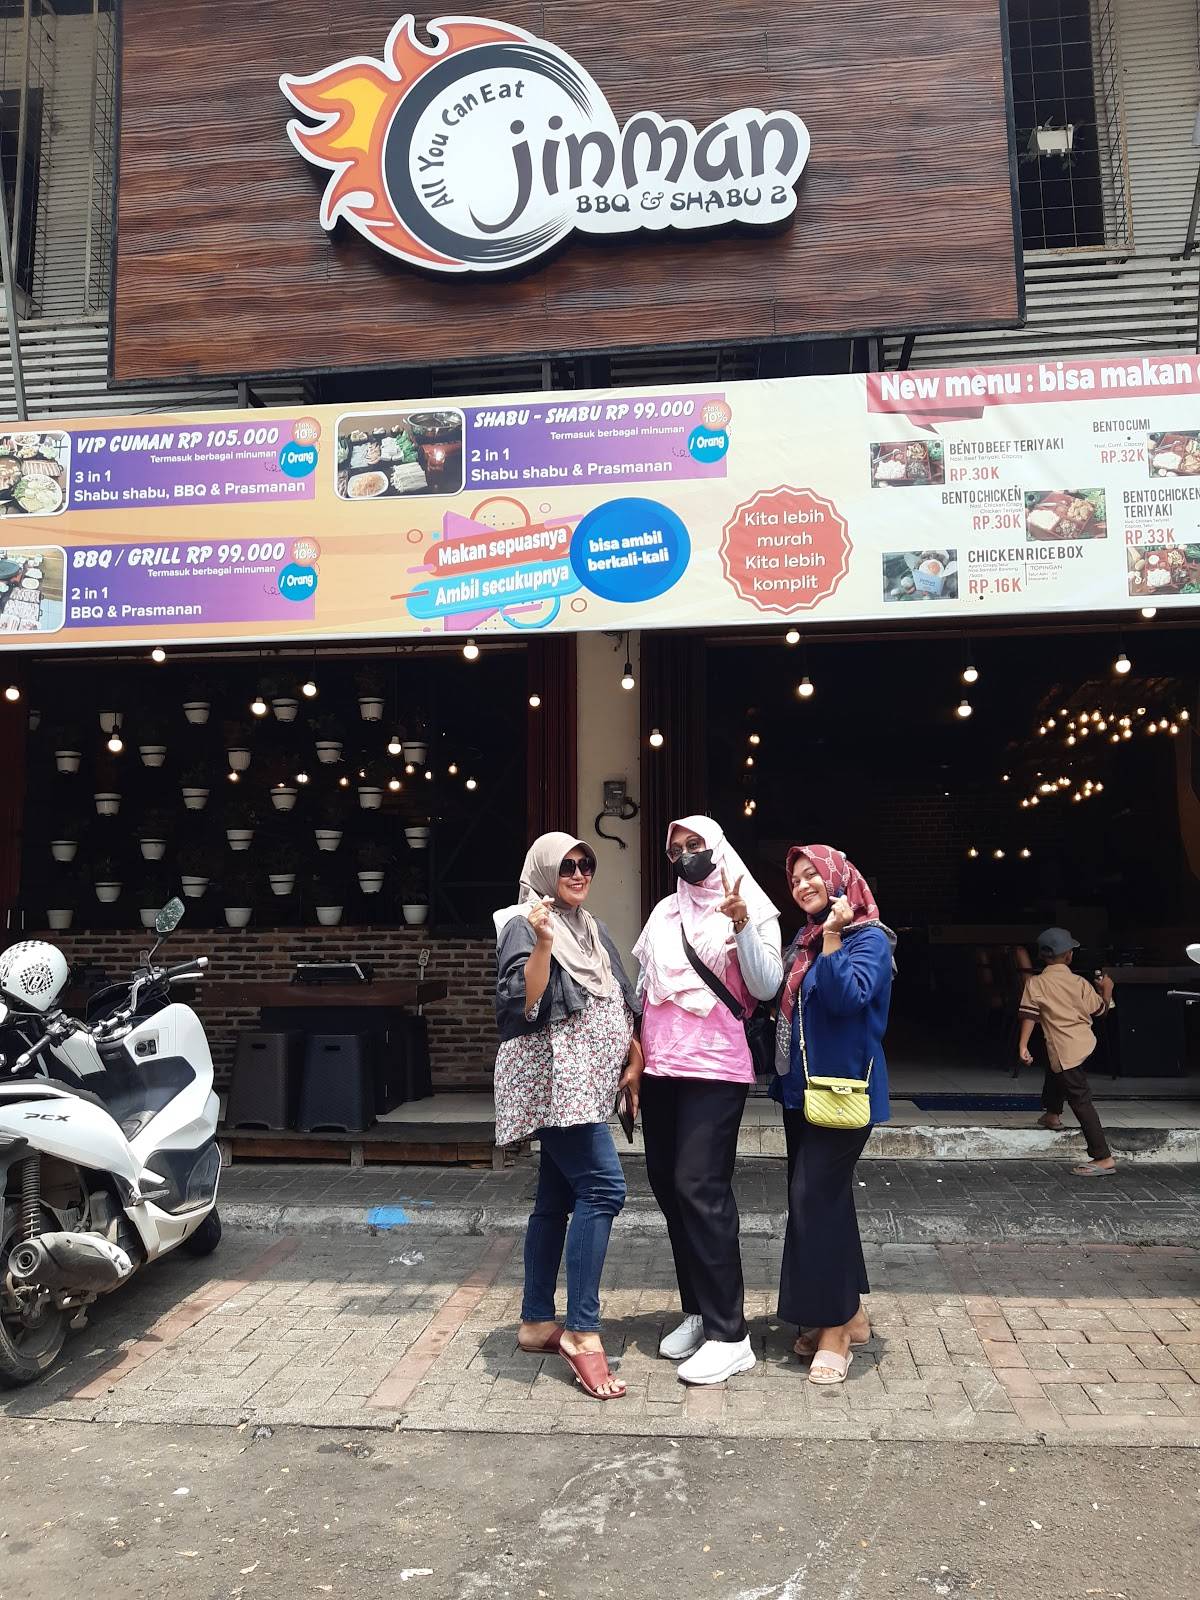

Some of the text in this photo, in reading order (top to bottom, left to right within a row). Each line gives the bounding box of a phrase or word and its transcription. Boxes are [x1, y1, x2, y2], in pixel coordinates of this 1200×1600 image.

[417, 80, 524, 208] All You Can Eat
[469, 115, 798, 234] jinman
[576, 194, 631, 213] BBQ
[640, 192, 664, 211] &
[670, 187, 762, 213] SHABU
[881, 375, 939, 400] New
[945, 371, 1021, 397] menu
[1039, 362, 1095, 392] bisa
[1100, 359, 1192, 388] makan
[474, 410, 529, 427] SHABU
[545, 406, 601, 424] SHABU
[605, 406, 629, 421] RP
[634, 400, 695, 419] 99.000
[703, 412, 728, 423] 10%
[550, 425, 685, 440] Termasuk berbagai minuman
[1093, 419, 1150, 432] BENTO CUMI
[77, 428, 279, 453] VIP CUMAN RP 105.000
[696, 436, 725, 448] Orang
[949, 437, 1064, 455] BENTO BEEF TERIYAKI
[150, 449, 277, 463] Termasuk berbagai minuman
[287, 452, 314, 464] Orang
[471, 448, 509, 462] 2 in 1
[75, 470, 111, 483] 3 in 1
[471, 461, 672, 482] Shabu shabu & Prasmanan
[74, 481, 305, 501] Shabu shabu, BBQ & Prasmanan
[942, 488, 1021, 504] BENTO CHICKEN
[1123, 488, 1200, 503] BENTO CHICKEN
[744, 509, 825, 526] Kita lebih
[1124, 504, 1172, 518] TERIYAKI
[438, 527, 567, 566] Makan sepuasnya
[589, 530, 662, 552] bisa ambil
[757, 531, 813, 547] murah
[72, 549, 112, 568] BBQ
[128, 547, 181, 565] GRILL
[186, 545, 213, 564] RP
[218, 543, 285, 563] 99.000
[294, 548, 317, 559] 10%
[587, 548, 669, 571] berkali-kali
[745, 553, 826, 569] Kita lebih
[968, 545, 1083, 562] CHICKEN RICE BOX
[148, 565, 276, 577] Termasuk berbagai minuman
[287, 574, 314, 587] Orang
[435, 565, 569, 606] Ambil secukupnya
[753, 575, 818, 592] komplit
[72, 587, 108, 599] 2 in 1
[71, 604, 202, 619] BBQ & Prasmanan
[24, 1112, 71, 1122] PCX
